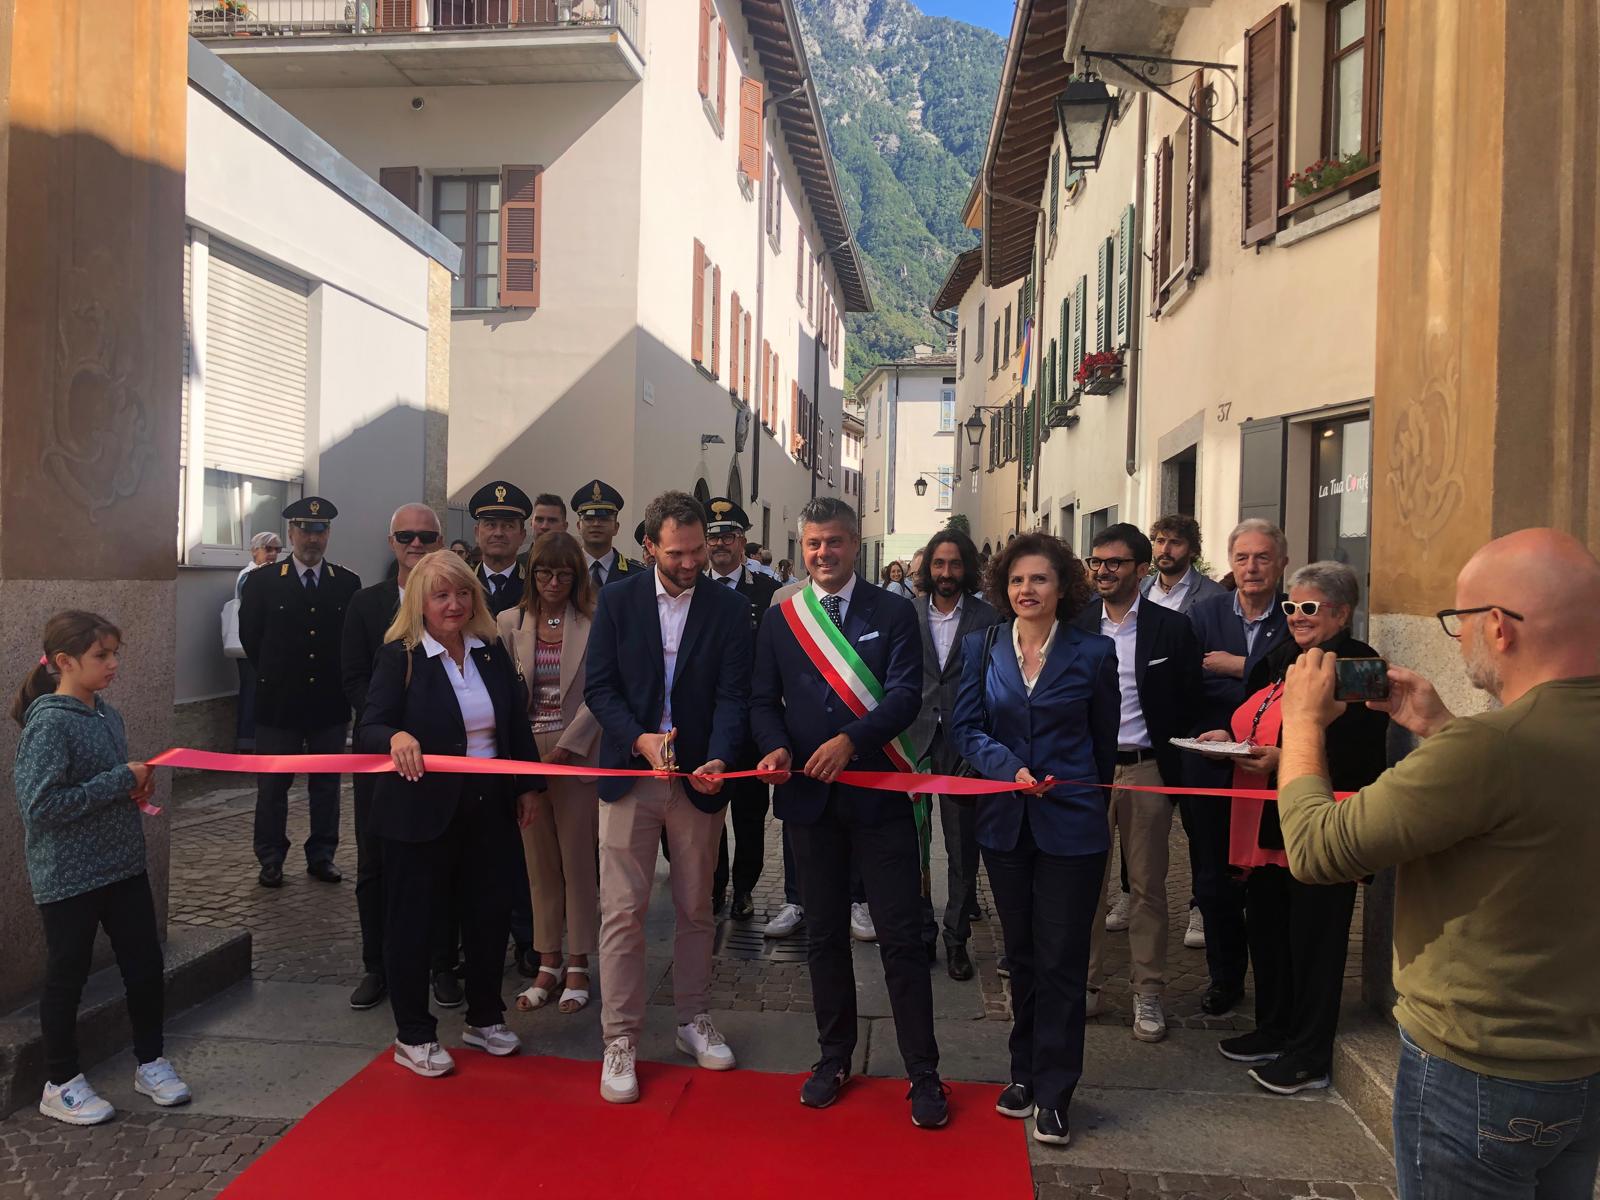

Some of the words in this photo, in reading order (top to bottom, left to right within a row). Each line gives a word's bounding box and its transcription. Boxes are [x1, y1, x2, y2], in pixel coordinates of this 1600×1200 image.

[1218, 401, 1232, 422] 37
[1318, 485, 1329, 498] La
[1330, 478, 1344, 496] Tua
